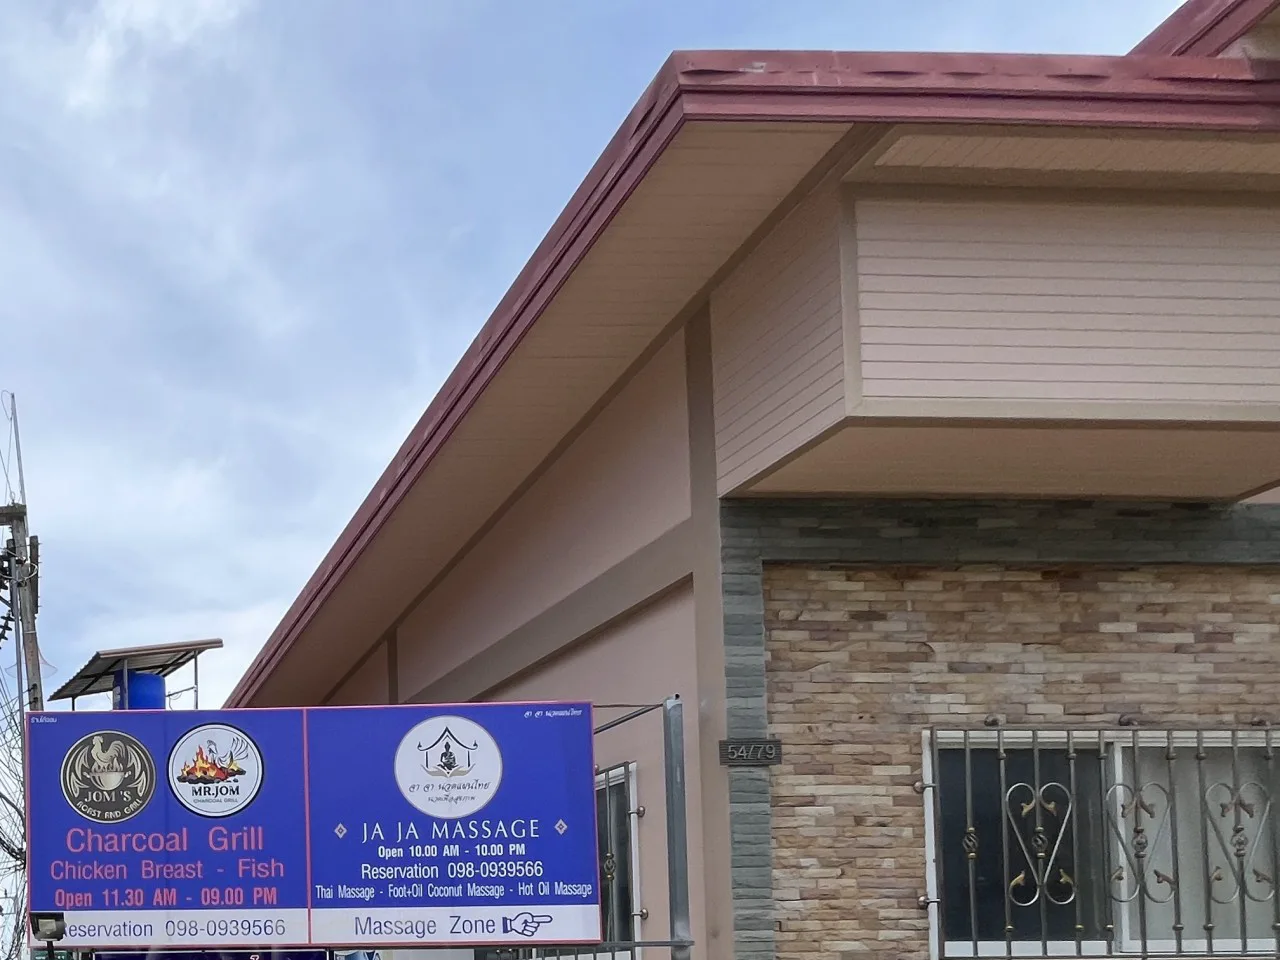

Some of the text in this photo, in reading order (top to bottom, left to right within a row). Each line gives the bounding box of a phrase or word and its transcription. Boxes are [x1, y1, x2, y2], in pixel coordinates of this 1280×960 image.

[728, 744, 776, 759] 54/79
[191, 786, 240, 798] MR.JOM
[105, 810, 121, 819] AND
[66, 826, 263, 852] Charcoal Grill
[362, 819, 540, 844] JA JA MASSAGE
[378, 845, 403, 860] Open
[409, 845, 437, 858] 10.00
[443, 845, 460, 857] AM
[475, 844, 503, 857] 10.00
[509, 843, 526, 856] PM
[50, 860, 127, 880] Chicken
[141, 859, 203, 879] Breast
[238, 858, 284, 878] Fish
[361, 861, 543, 879] Reservation 098-0939566
[55, 889, 92, 909] Open
[102, 889, 144, 907] 11.30
[153, 888, 177, 906] AM
[201, 888, 244, 905] 09.00
[253, 887, 277, 905] PM
[315, 885, 334, 899] Thai
[338, 884, 375, 900] Massage
[388, 884, 423, 898] Foot+Oil
[427, 883, 462, 898] Coconut
[467, 883, 505, 899] Massage
[518, 882, 534, 897] Hot
[538, 882, 550, 896] Oil
[554, 881, 592, 898] Massage
[64, 919, 286, 938] eservation 098-0939566
[354, 915, 496, 939] Massage Zone
